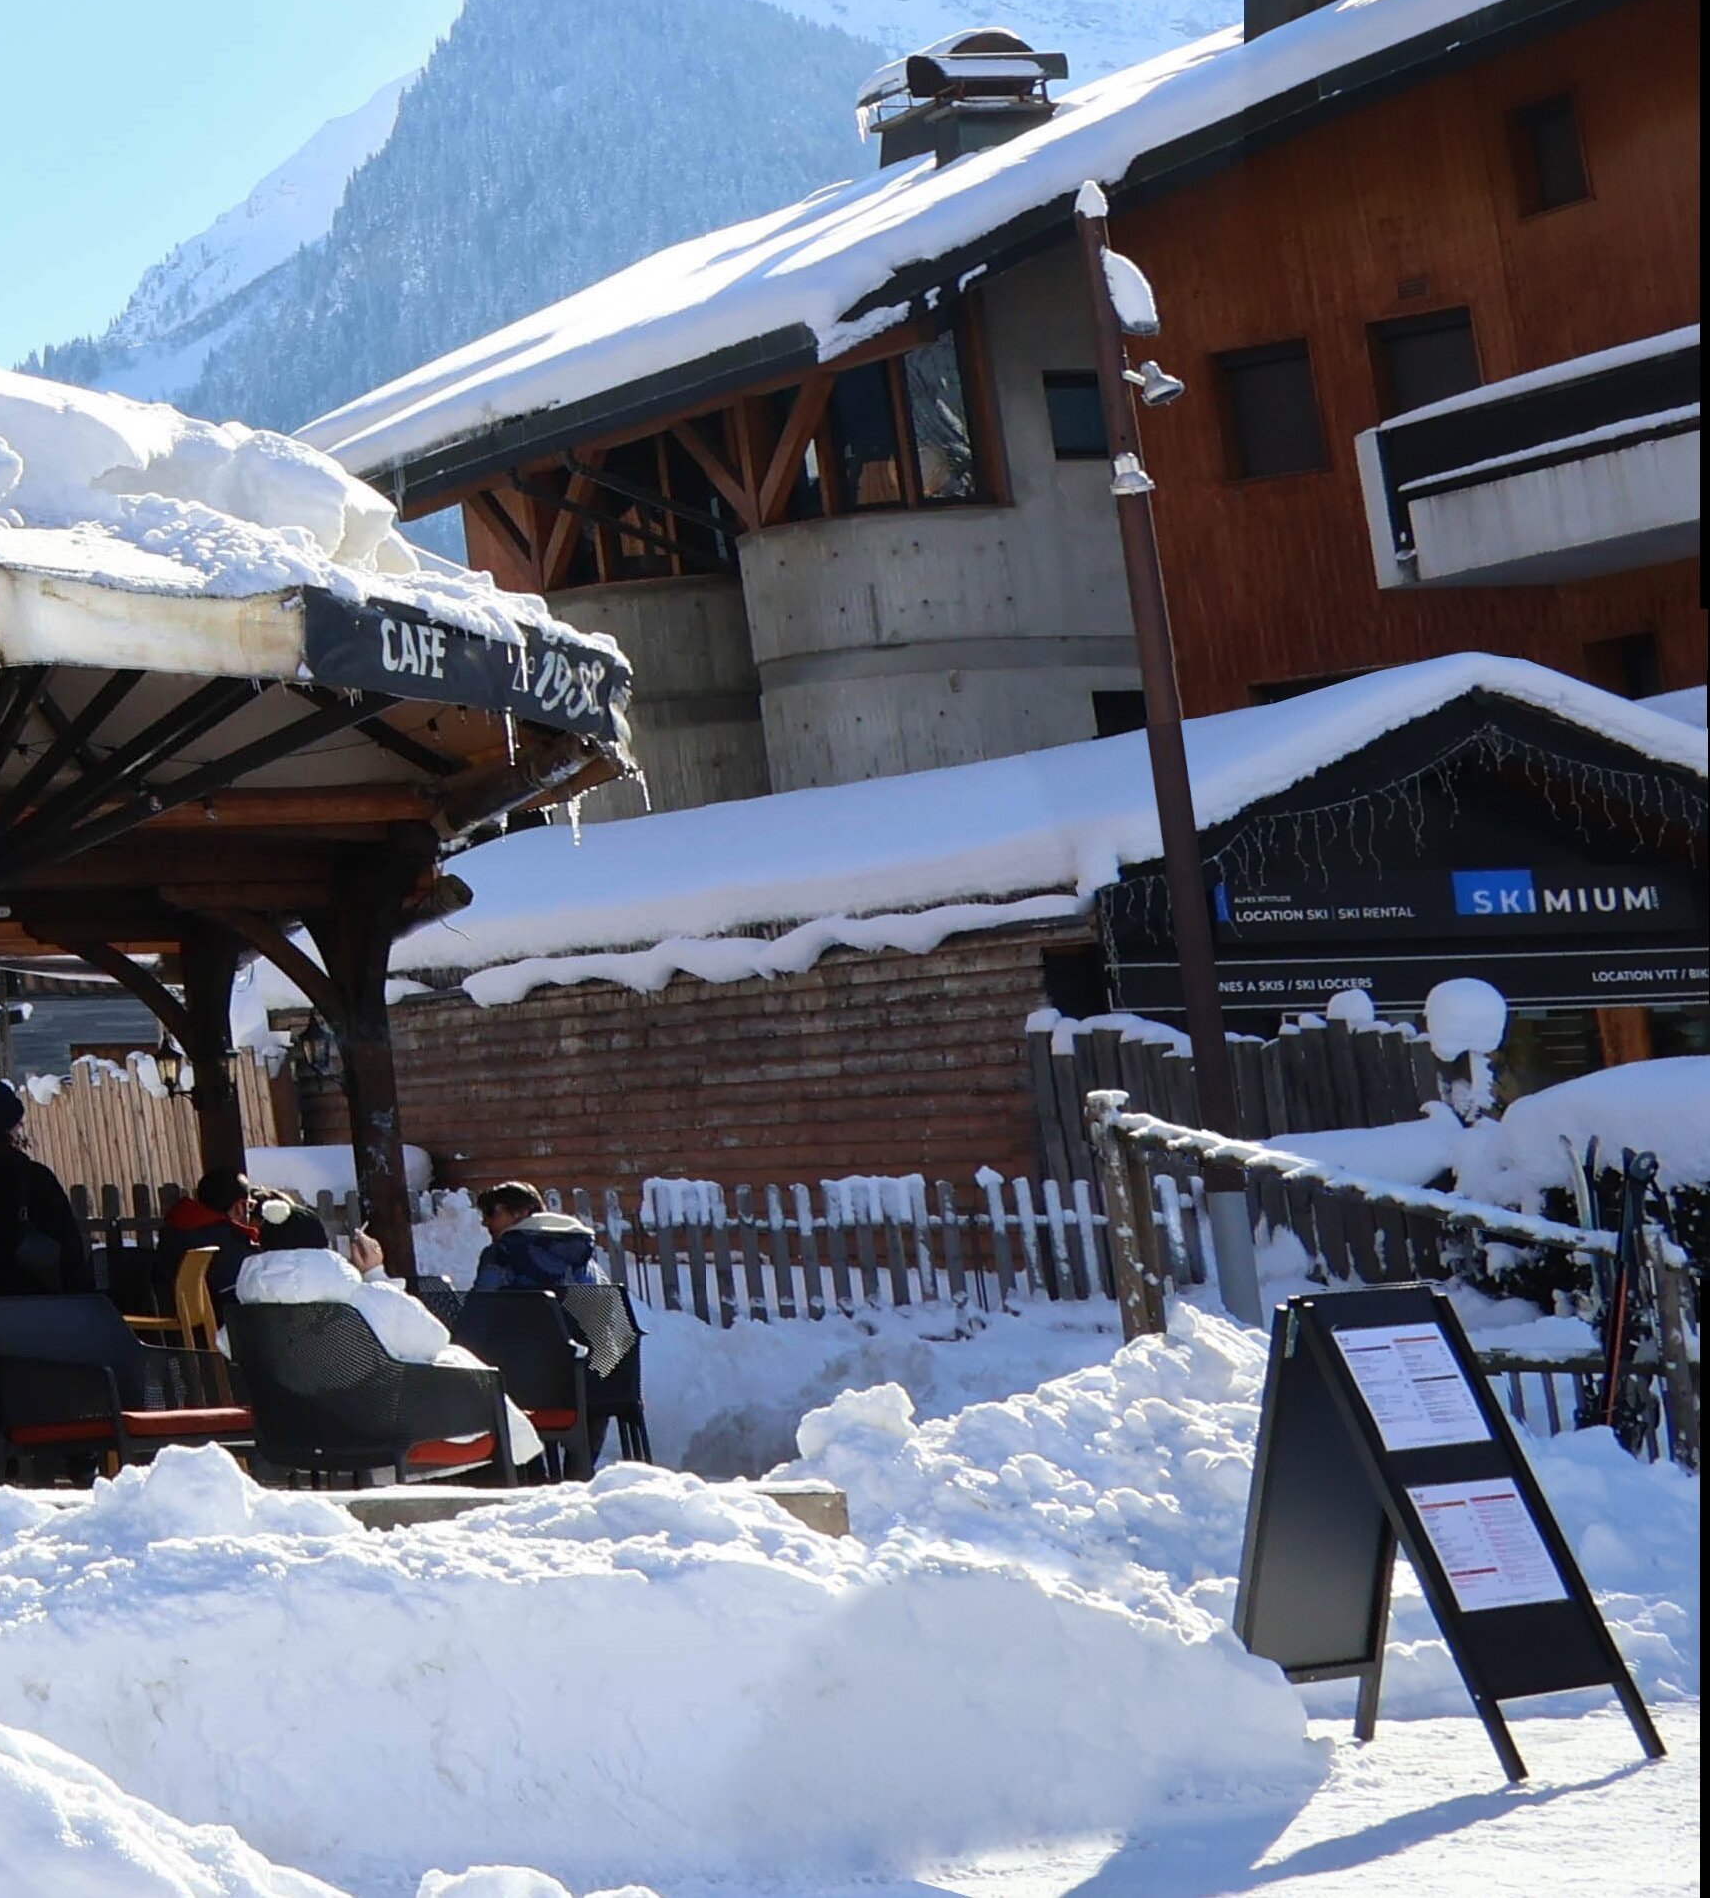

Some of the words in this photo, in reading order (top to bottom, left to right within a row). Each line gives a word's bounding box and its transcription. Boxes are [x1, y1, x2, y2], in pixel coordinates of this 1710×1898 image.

[1472, 886, 1653, 915] SKIMIUM
[1235, 909, 1304, 922] LOCATION
[1306, 908, 1329, 921] SKI
[1337, 907, 1360, 920] SKI
[1362, 906, 1416, 919] RENTAL
[1591, 969, 1654, 983] LOCATION
[1654, 968, 1679, 980] VTT
[1688, 967, 1709, 979] BIK
[1246, 981, 1257, 992] A
[1258, 979, 1285, 991] SKIS
[1295, 979, 1316, 991] SKI
[1317, 977, 1373, 990] LOCKERS
